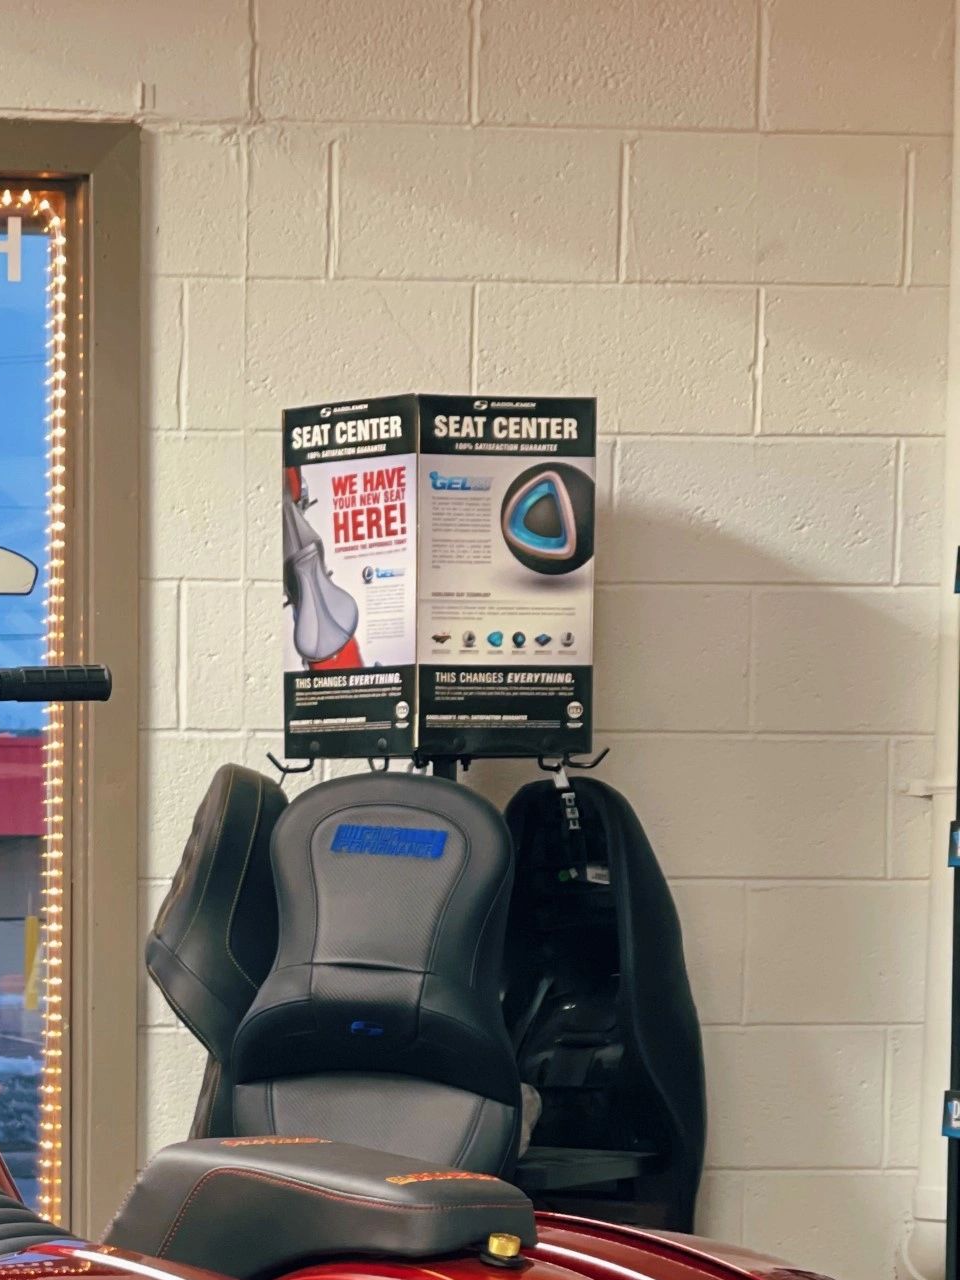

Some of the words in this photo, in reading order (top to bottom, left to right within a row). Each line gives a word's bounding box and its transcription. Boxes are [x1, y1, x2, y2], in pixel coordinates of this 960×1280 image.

[291, 423, 332, 449] SEAT
[335, 415, 403, 444] CENTER
[433, 414, 487, 438] SEAT
[492, 416, 578, 440] CENTER
[474, 442, 518, 451] SATISFACTION
[520, 443, 558, 452] GUARANTEE
[331, 473, 358, 497] WE
[362, 466, 406, 493] HAVE
[333, 495, 357, 510] YOUR
[359, 491, 382, 507] NEW
[383, 487, 406, 503] SEAT
[333, 502, 407, 545] HERE!
[295, 677, 312, 689] THIS
[313, 675, 347, 689] CHANGES
[348, 672, 403, 687] EVERYTHING.
[435, 671, 457, 683] THIS
[459, 672, 504, 684] CHANGES
[507, 672, 576, 684] EVERYTHING.
